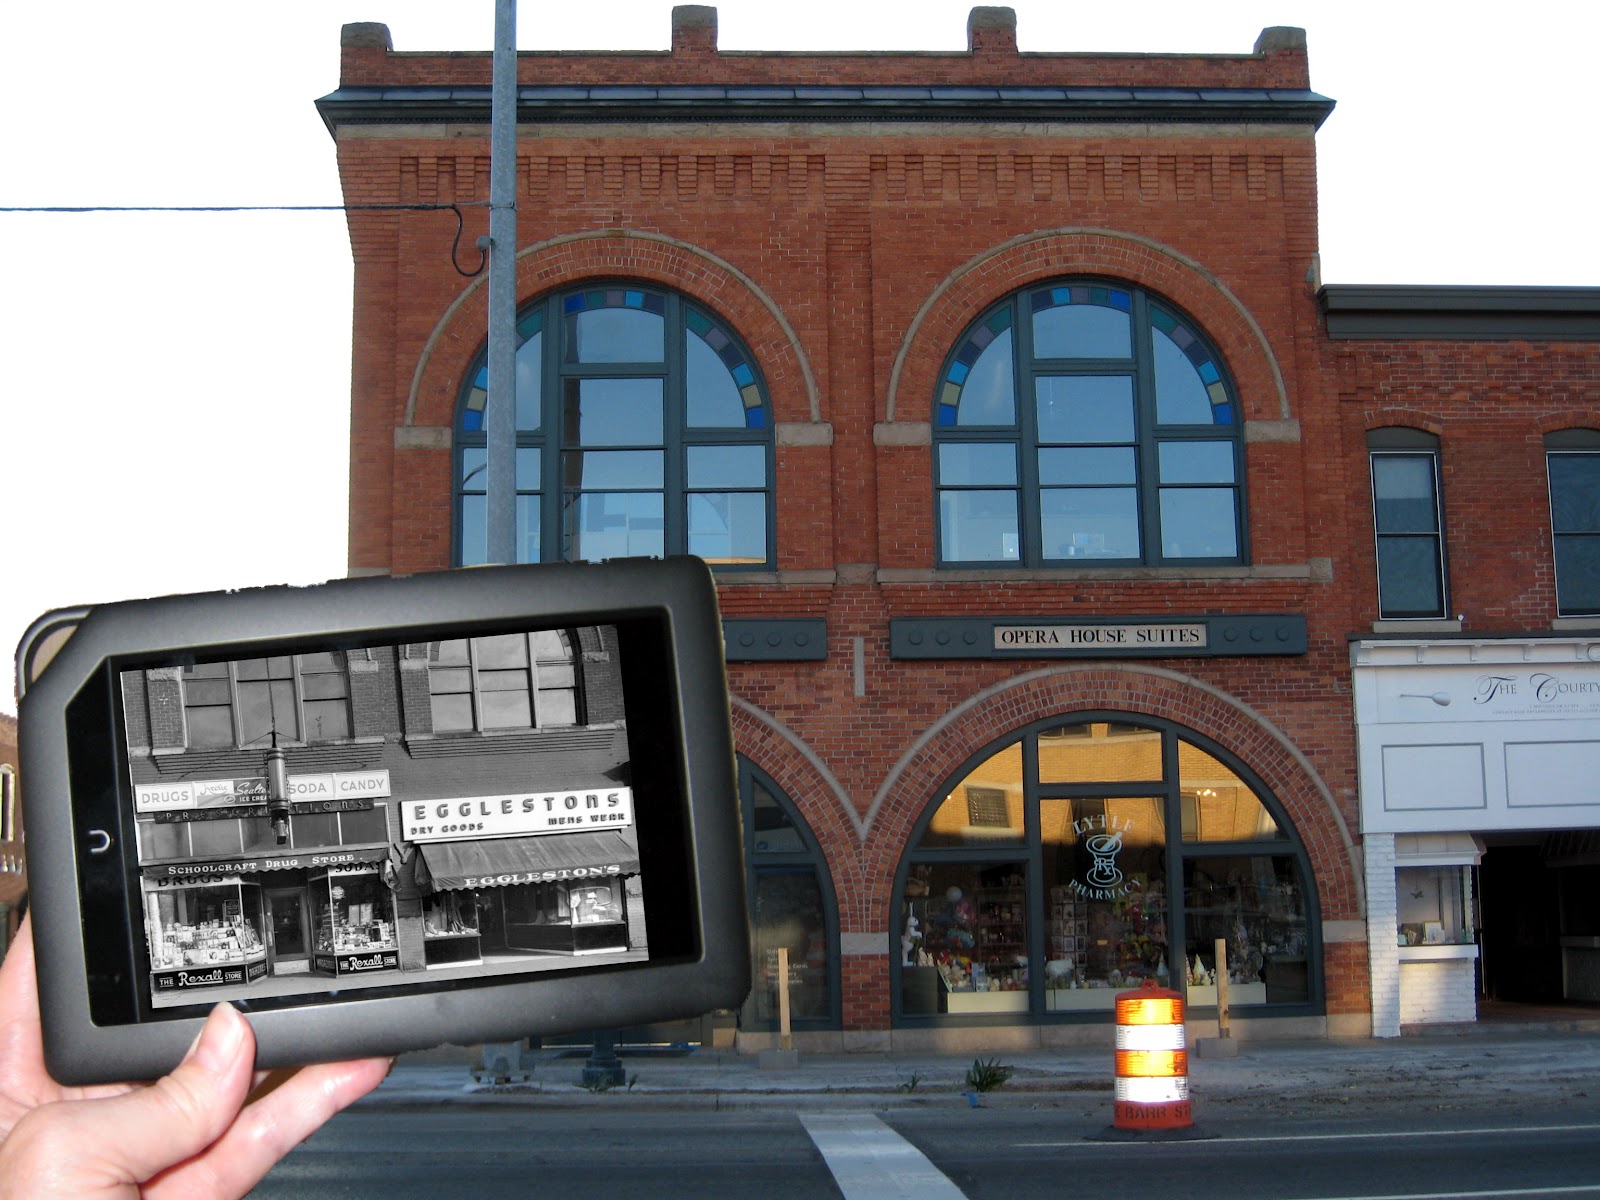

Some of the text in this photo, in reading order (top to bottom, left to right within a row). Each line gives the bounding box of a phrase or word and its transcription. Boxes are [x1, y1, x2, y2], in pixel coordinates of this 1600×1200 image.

[1001, 628, 1200, 644] OPERA HOUSE SUITES
[289, 778, 385, 795] SODA CANDY
[141, 790, 189, 804] DRUGS
[166, 801, 364, 821] PRESCRITIONS
[414, 793, 620, 820] EGGLESTONS
[548, 813, 625, 826] MENS WEAR
[1072, 814, 1134, 835] LYTLE
[410, 822, 484, 836] DRY GOODS
[168, 862, 257, 875] SCHOOLCRAFT
[265, 859, 298, 869] DRUG
[464, 865, 621, 887] EGGLESTON'S
[1068, 876, 1141, 900] PHARMACY
[348, 954, 384, 971] Rexall
[159, 969, 242, 987] THE Rexall STORE
